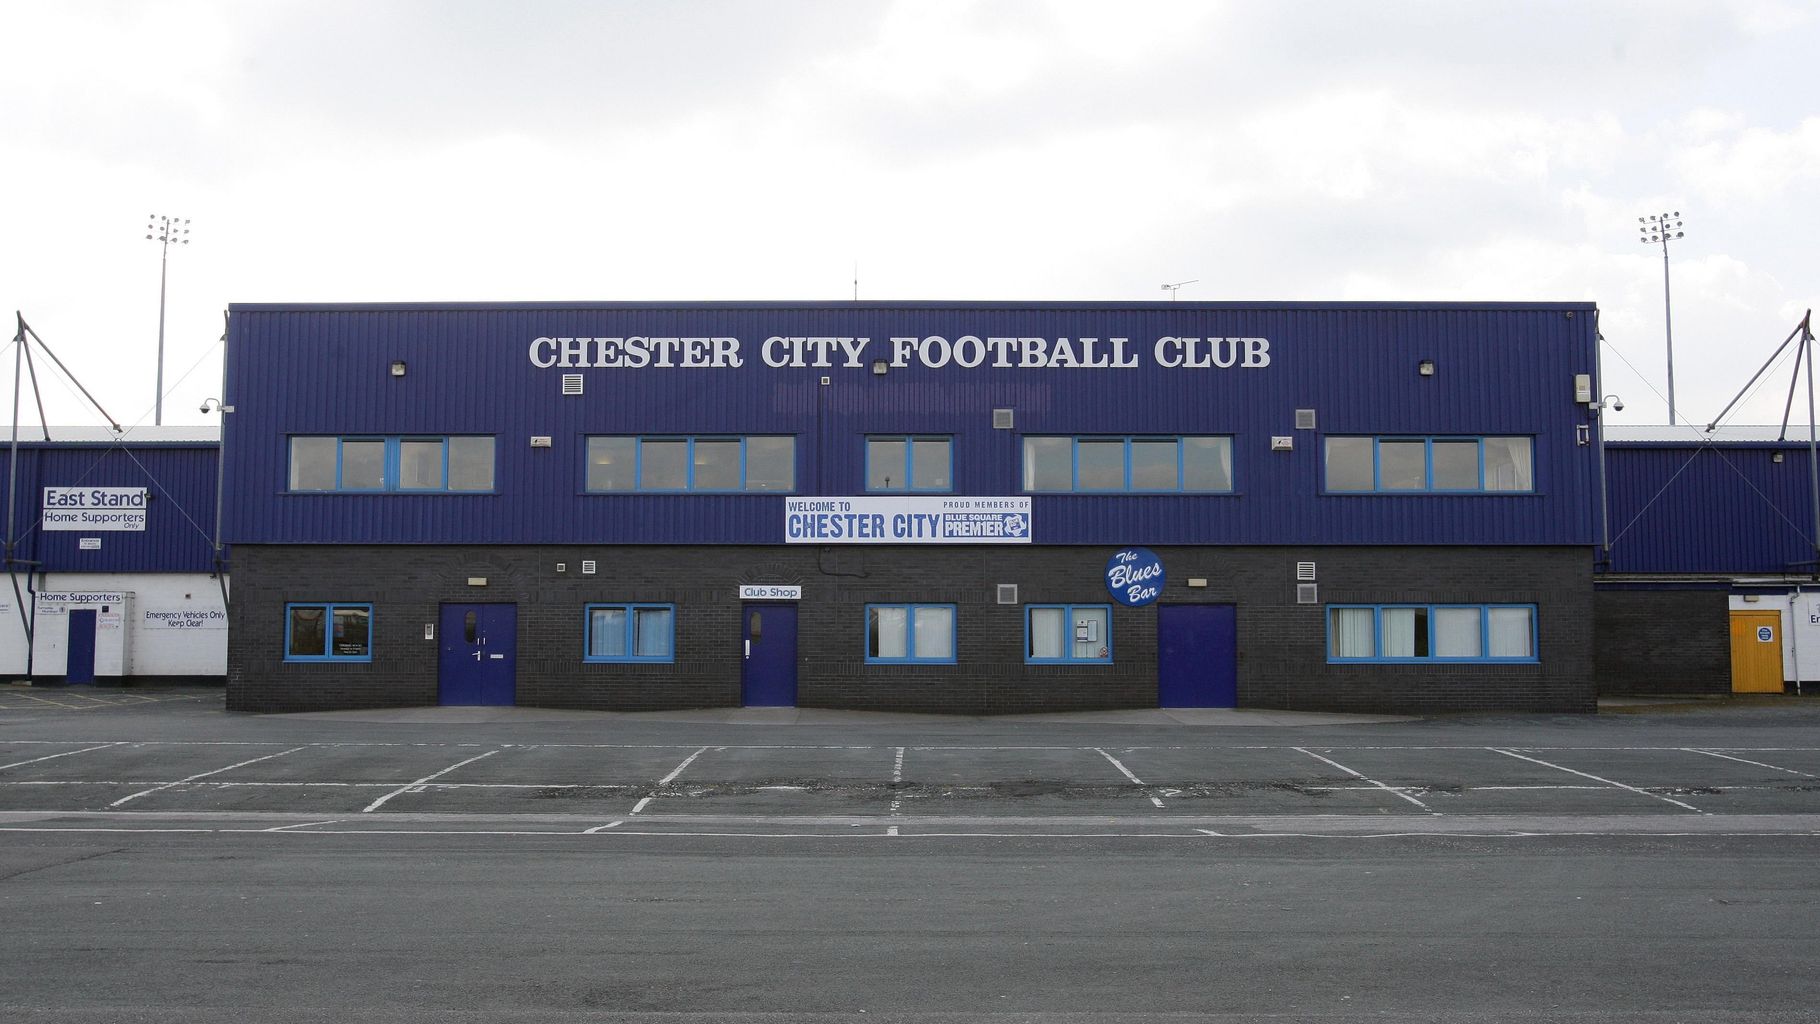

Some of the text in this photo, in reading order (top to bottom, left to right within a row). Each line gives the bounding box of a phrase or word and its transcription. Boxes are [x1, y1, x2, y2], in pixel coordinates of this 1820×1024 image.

[528, 335, 1271, 368] CHESTER CITY FOOTBALL CLUB
[46, 490, 144, 506] East Stand
[788, 501, 851, 512] WELCOME TO
[44, 512, 144, 524] Home Supporters
[123, 522, 140, 530] Only
[788, 513, 940, 538] CHESTER CITY
[1115, 551, 1138, 563] The
[1108, 562, 1162, 589] Blues
[40, 592, 121, 604] Home Supporters
[744, 587, 798, 598] Club Shop
[1127, 584, 1157, 603] Bar
[145, 610, 226, 620] Emergency Vehicles Only
[167, 620, 185, 629] Keep
